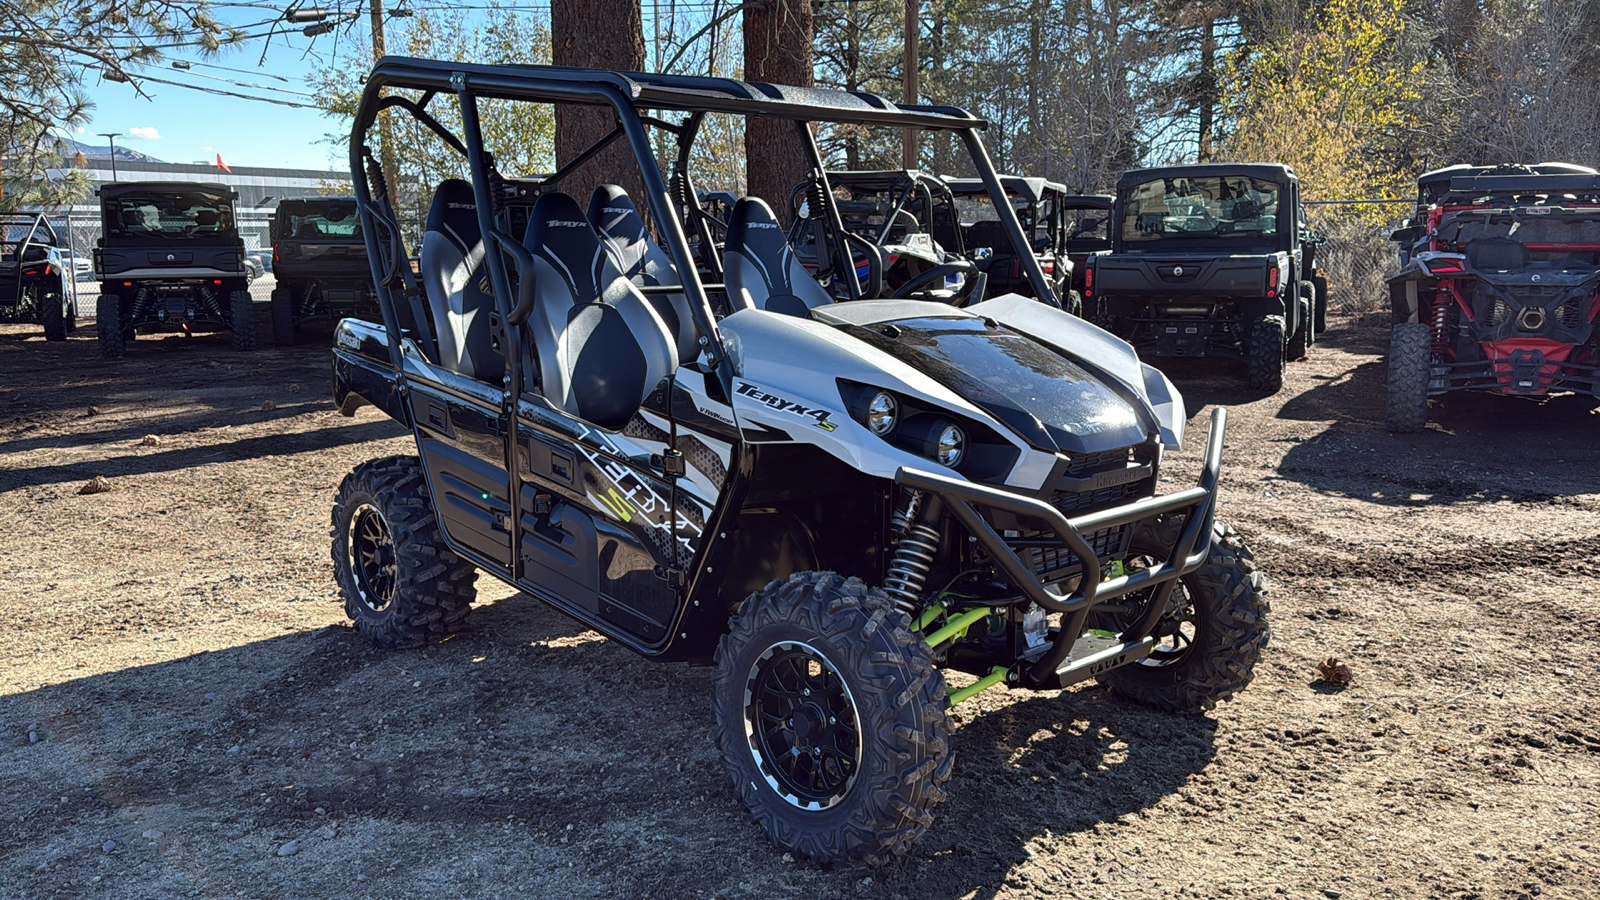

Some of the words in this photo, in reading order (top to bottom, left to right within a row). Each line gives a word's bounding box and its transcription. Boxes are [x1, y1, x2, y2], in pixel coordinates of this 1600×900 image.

[447, 202, 476, 210] TERY
[546, 219, 588, 228] TERYX
[746, 221, 777, 229] TERYX
[1096, 469, 1137, 488] Kawasaki
